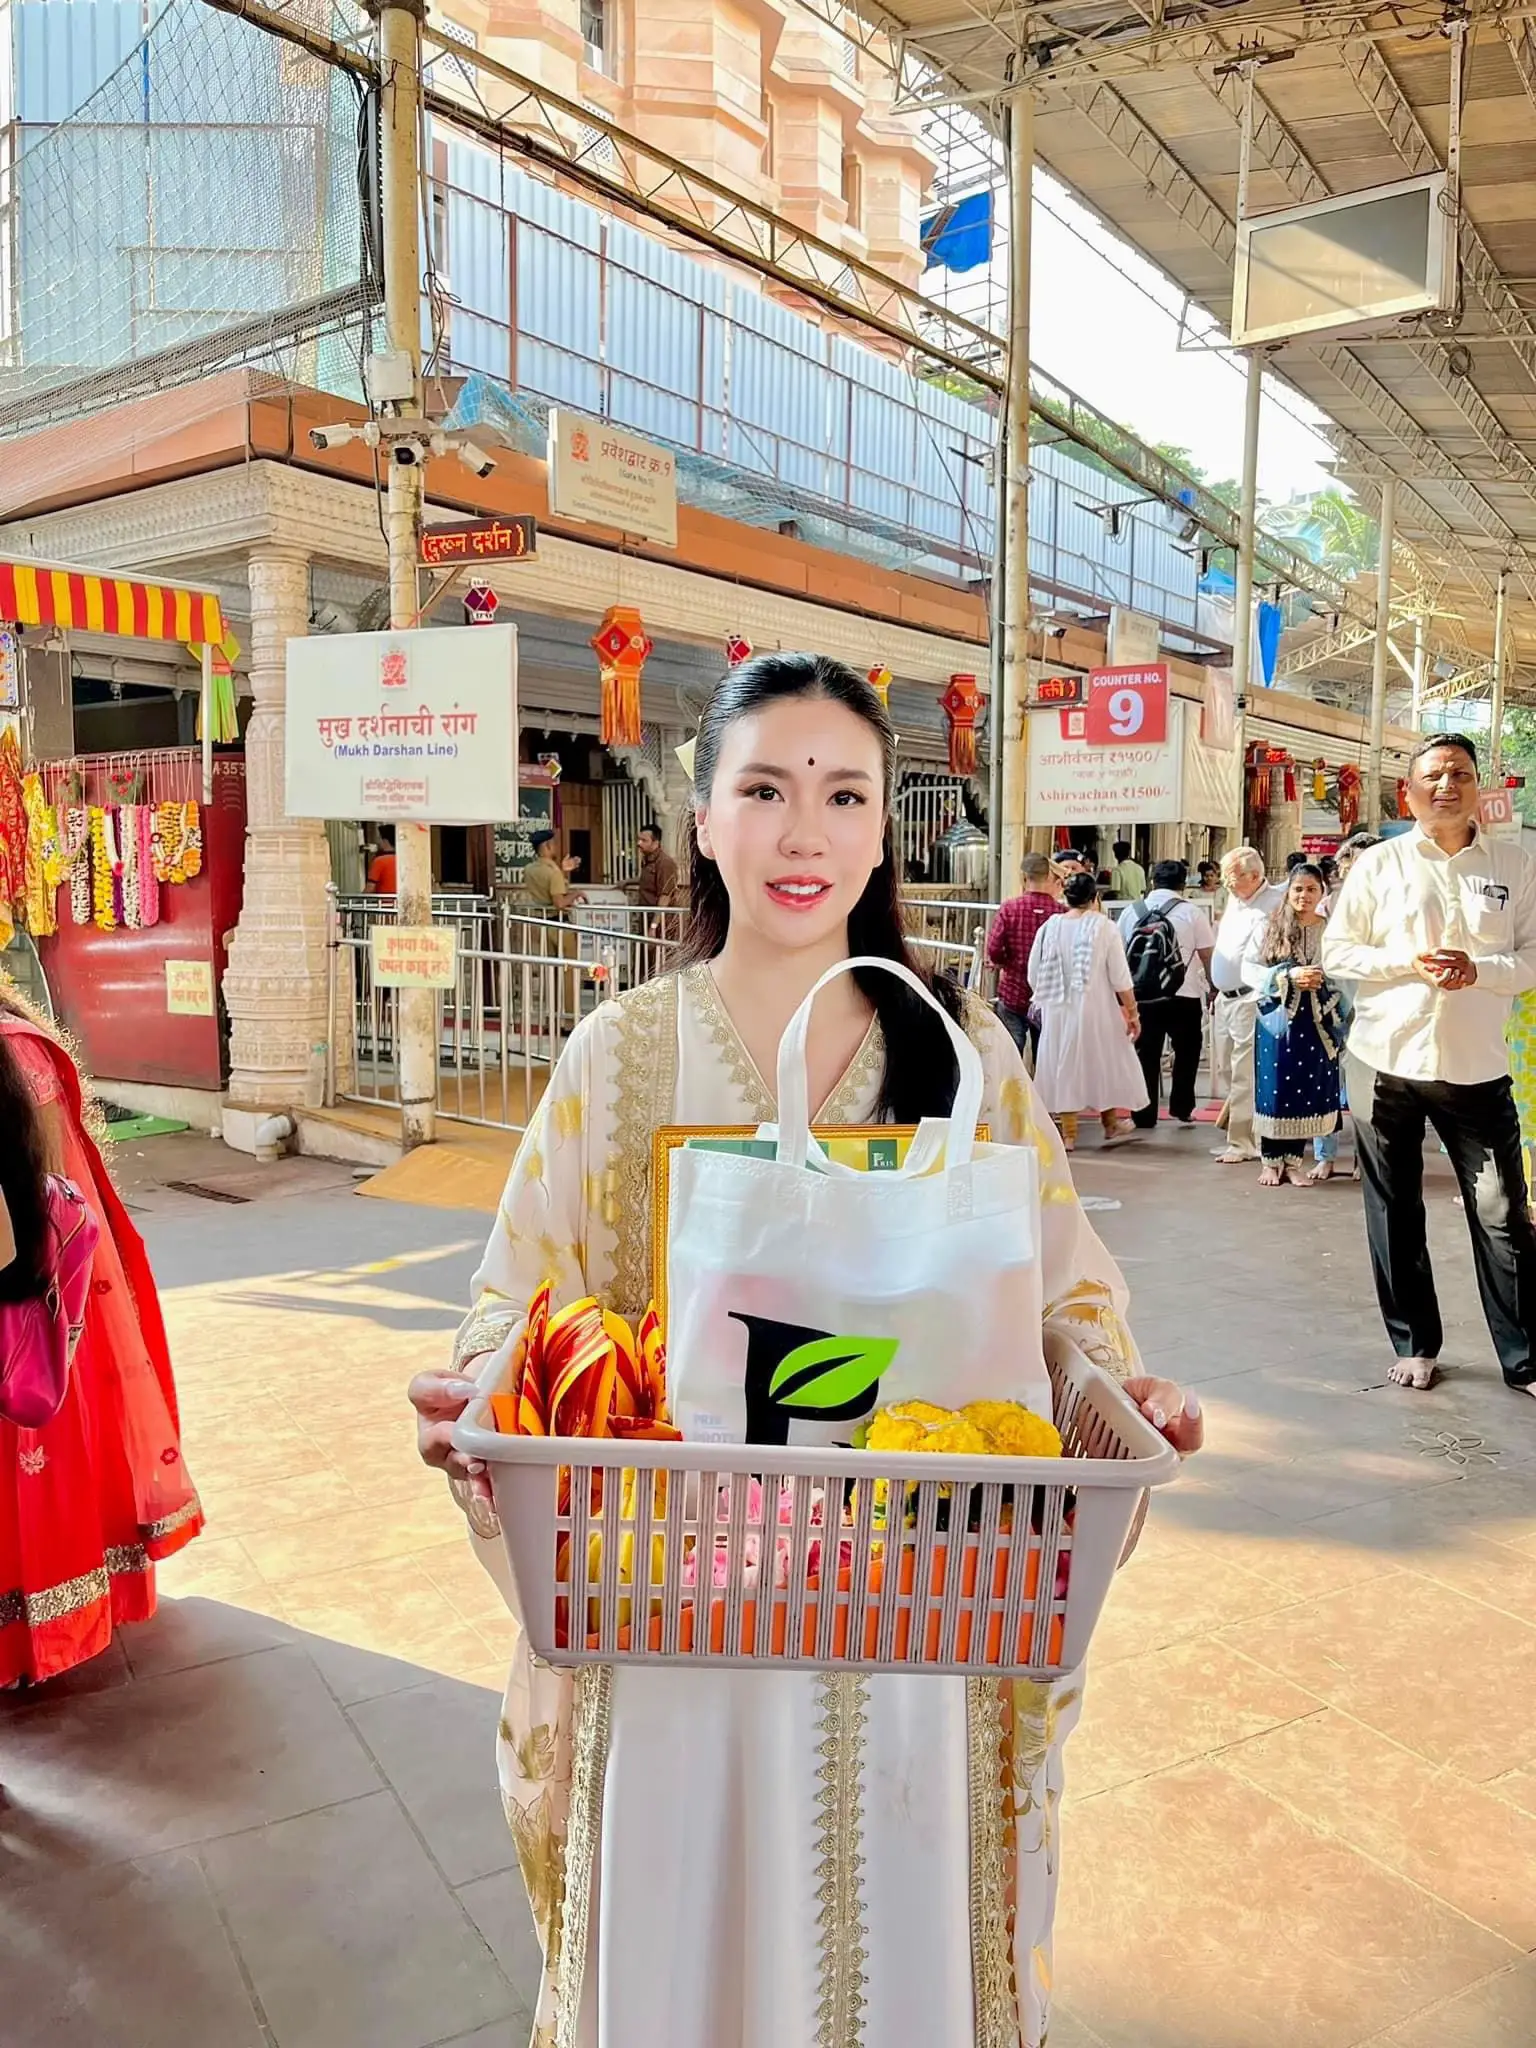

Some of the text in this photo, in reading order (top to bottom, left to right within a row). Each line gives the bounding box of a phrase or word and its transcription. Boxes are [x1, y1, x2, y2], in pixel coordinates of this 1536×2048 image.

[1093, 672, 1162, 688] COUNTER NO.
[1108, 688, 1144, 737] 9
[316, 701, 478, 749] मुख दर्शनाची रांग
[334, 743, 459, 759] (Mukh Darshan Line)
[1037, 788, 1118, 802] Ashirvachan
[1483, 799, 1506, 820] 10
